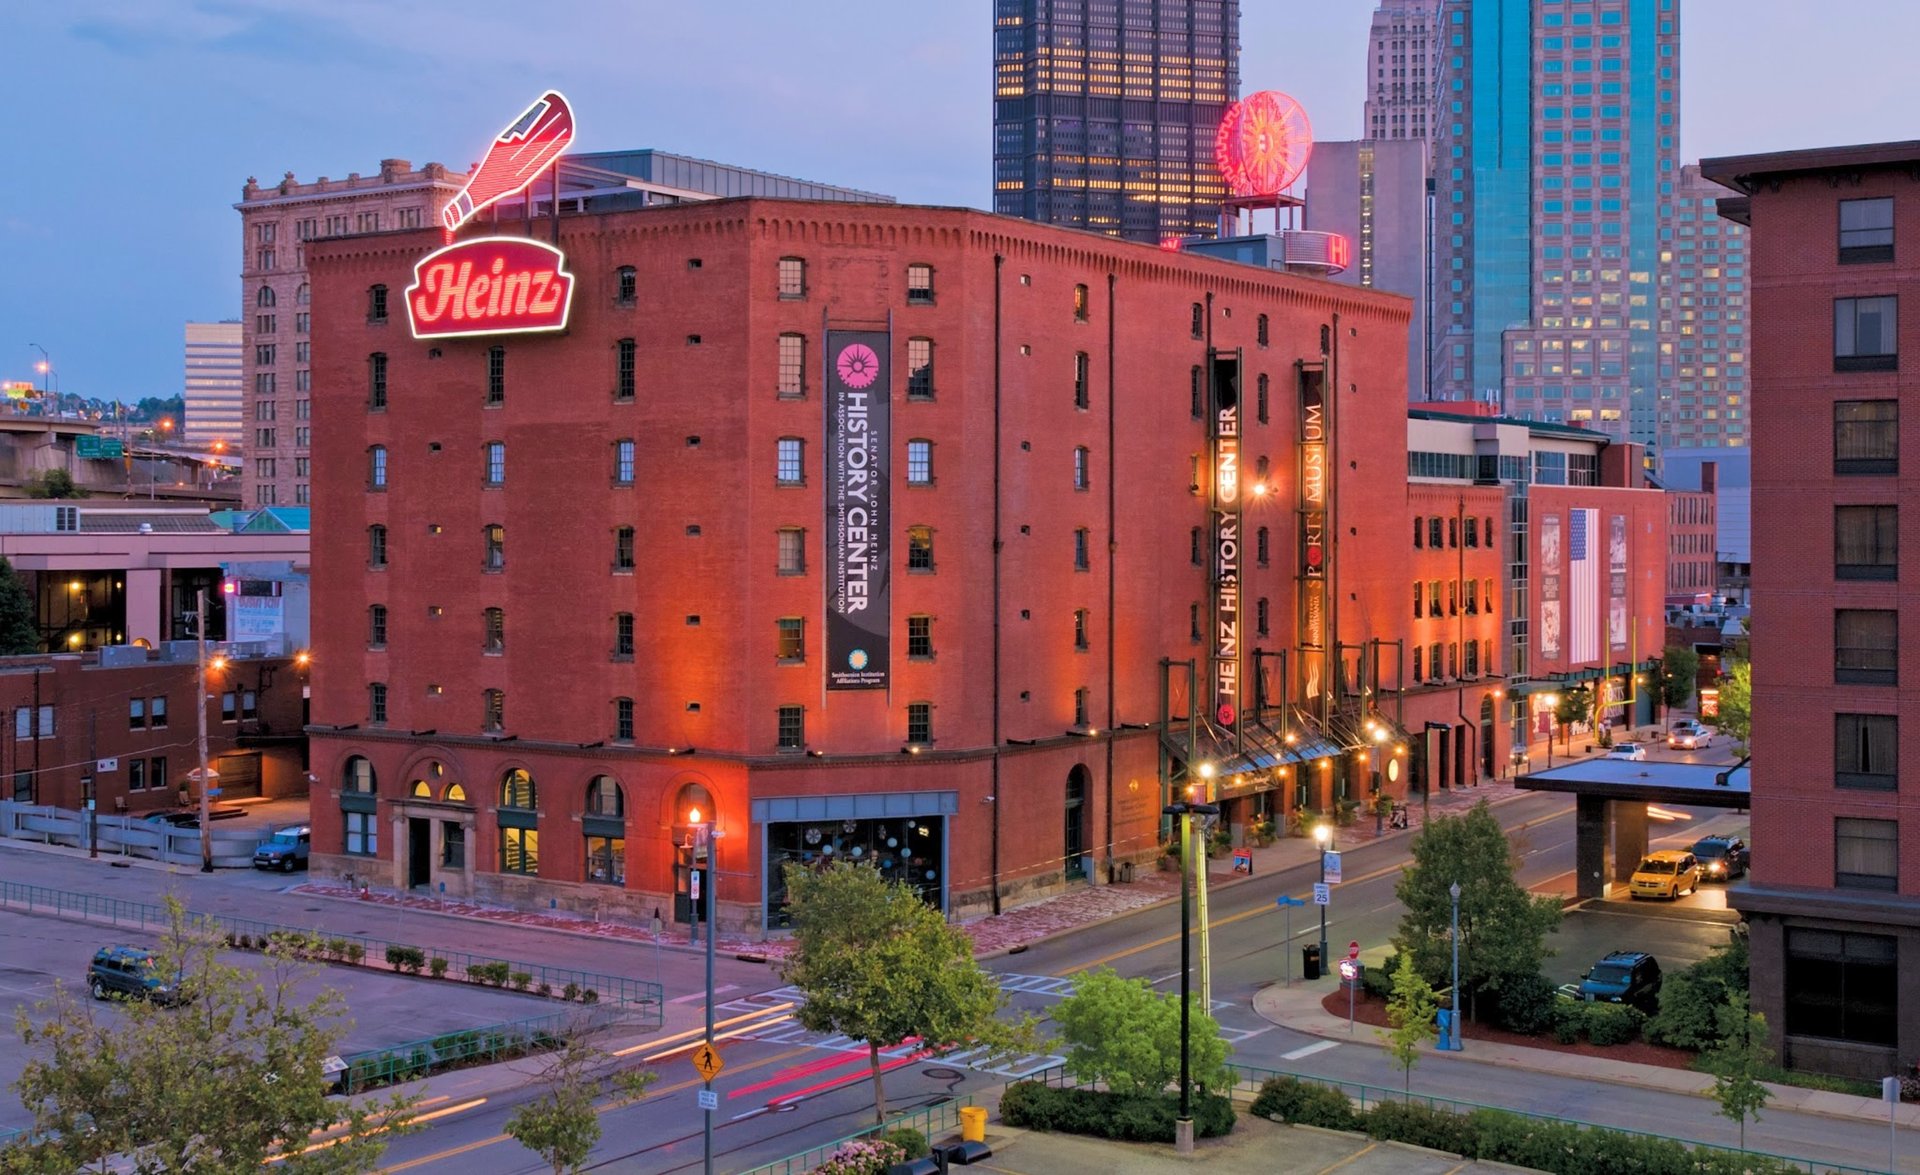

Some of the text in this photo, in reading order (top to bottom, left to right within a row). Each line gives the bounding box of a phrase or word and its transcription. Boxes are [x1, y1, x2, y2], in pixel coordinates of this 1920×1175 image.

[415, 257, 562, 322] Heinz
[838, 392, 845, 401] IN
[847, 392, 868, 614] HISTORY CENTER
[870, 430, 878, 571] SENATOR JOHN HEINZ
[1219, 405, 1237, 695] HENZ HISTORY CENTER
[1316, 894, 1328, 902] 25
